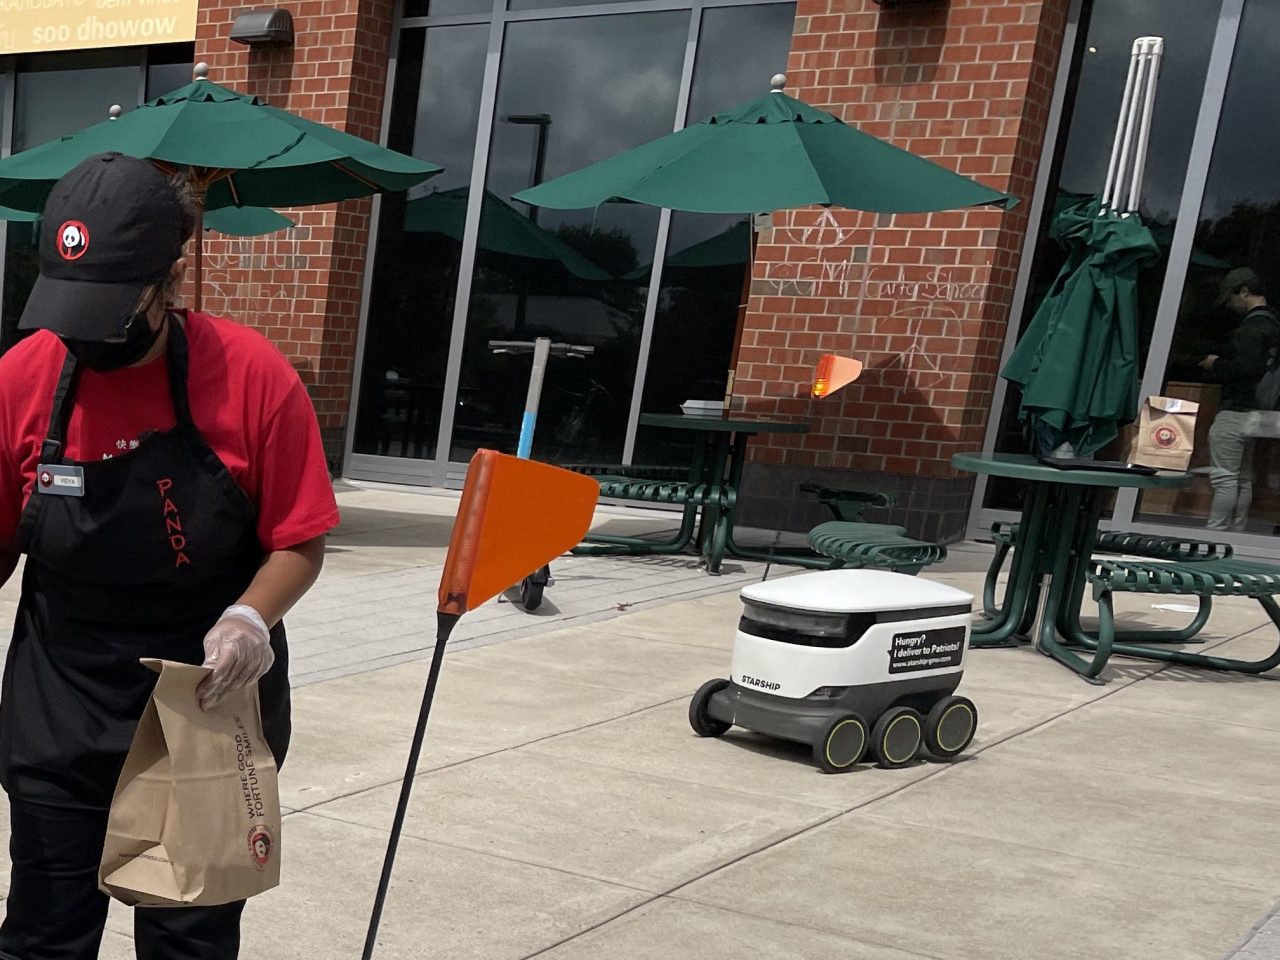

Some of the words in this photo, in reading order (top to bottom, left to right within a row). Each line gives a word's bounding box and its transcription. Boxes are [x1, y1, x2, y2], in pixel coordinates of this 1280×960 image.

[32, 24, 70, 45] soo
[77, 16, 177, 41] dhowow
[156, 478, 190, 567] PANDA
[895, 634, 926, 647] Hungry?
[898, 648, 922, 657] deliver
[923, 646, 930, 655] to
[931, 641, 960, 653] Patriots!
[741, 675, 781, 691] STARSHIP
[235, 735, 246, 772] GOOD
[242, 775, 255, 819] WHERE
[246, 761, 265, 817] FORTUNE
